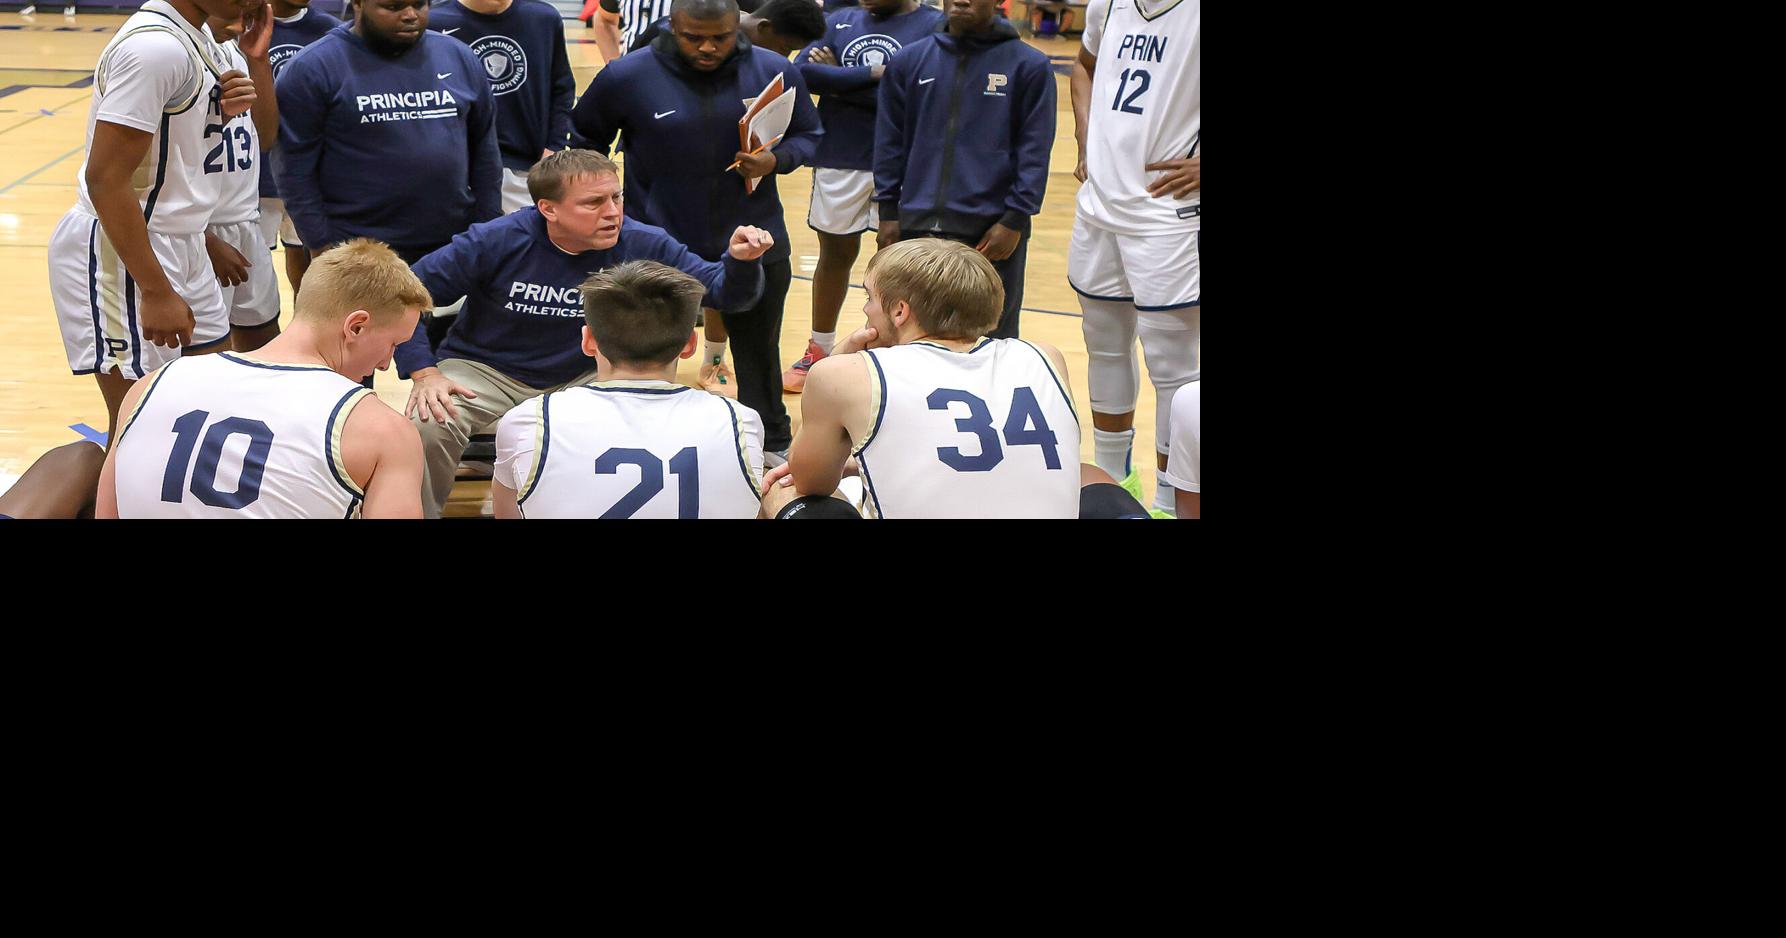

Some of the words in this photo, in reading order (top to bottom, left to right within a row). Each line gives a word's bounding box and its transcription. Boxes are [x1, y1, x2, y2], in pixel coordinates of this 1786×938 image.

[473, 41, 521, 62] GH-MINDED
[848, 39, 897, 57] HIGH-MINDE
[1117, 34, 1168, 63] PRIN
[987, 73, 1007, 91] P
[1112, 68, 1151, 115] 12
[356, 89, 456, 112] PRINCIPIA
[360, 111, 422, 124] ATHLETICS
[504, 301, 577, 318] ATHLETICS
[105, 337, 128, 357] P
[926, 387, 1061, 472] 34
[161, 409, 274, 509] 10
[595, 447, 699, 519] 21
